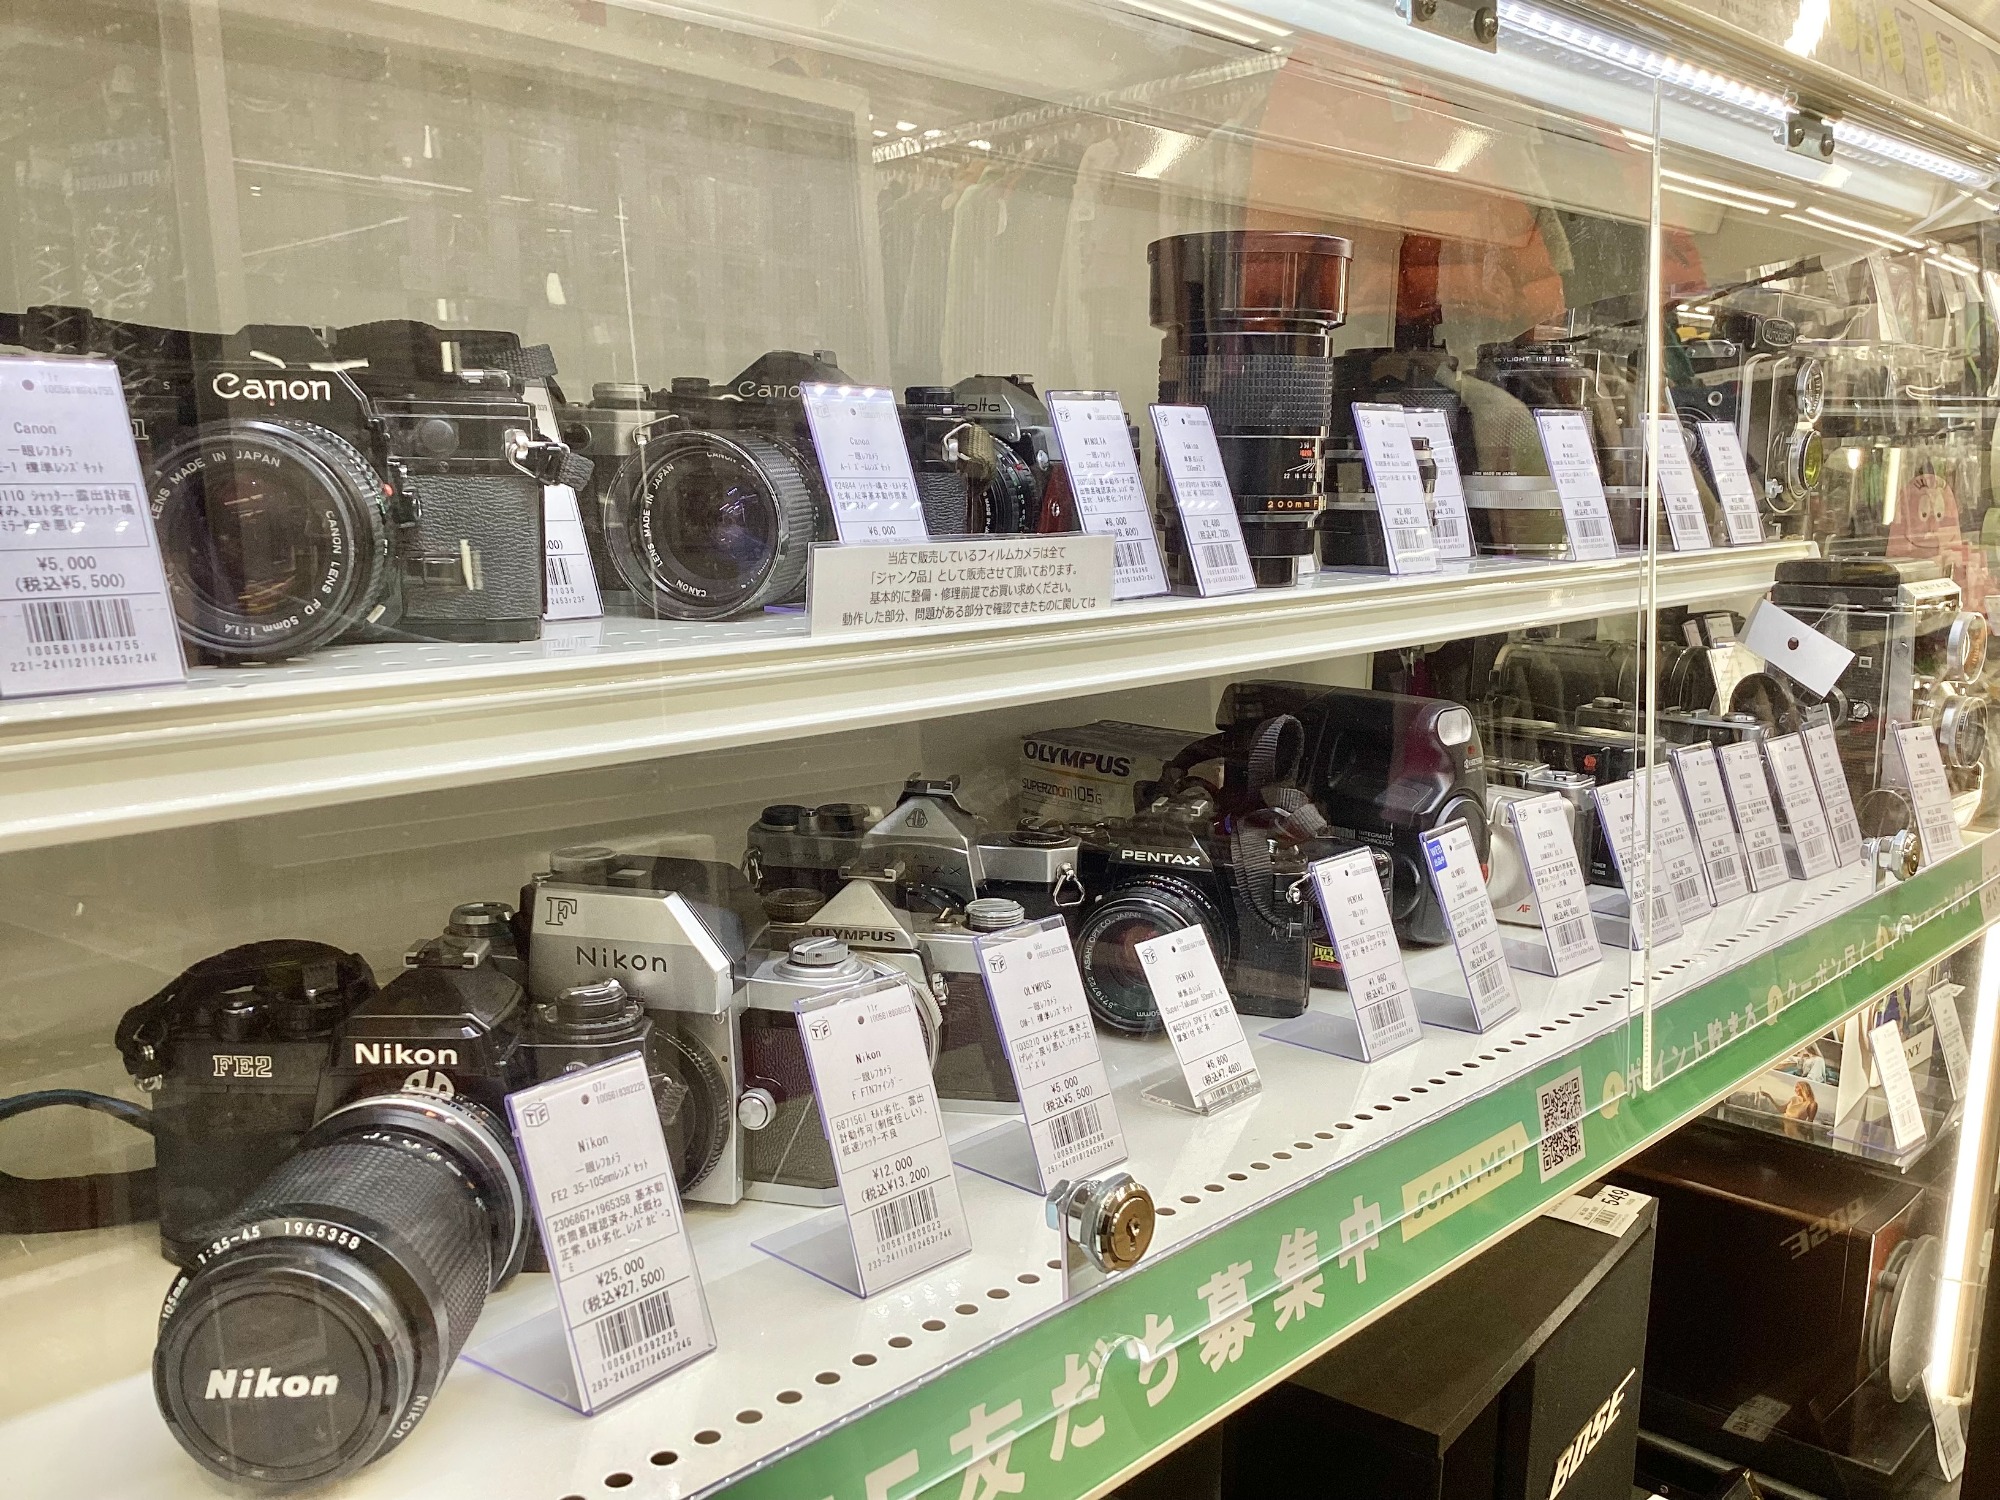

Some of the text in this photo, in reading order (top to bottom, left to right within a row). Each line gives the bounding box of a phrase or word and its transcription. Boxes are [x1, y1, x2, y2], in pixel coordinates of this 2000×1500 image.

[213, 372, 331, 401] Canon
[738, 381, 801, 400] Cano
[14, 422, 56, 434] Canon
[150, 450, 281, 520] LENS MADE IN JAPAN
[643, 508, 652, 538] MADE
[652, 463, 675, 490] JAPAN
[868, 526, 896, 536] ¥6,000
[1104, 516, 1128, 526] ¥8,000
[325, 510, 342, 554] CANON
[37, 556, 96, 572] ¥5,000
[888, 546, 1067, 566] 当店で販売しているフィルムカメラは全て
[16, 573, 126, 593] (税込¥5,500)
[321, 562, 341, 595] LENS
[870, 564, 1078, 585] 「ジャンク品」として販売させて頂いております。
[676, 578, 707, 598] CANON
[870, 582, 1072, 605] 基本的に整備・修理前提でお買い求めください。
[304, 598, 322, 616] FD
[842, 597, 1096, 626] 動作した部分、問題がある部分で確認できたものに関しては
[1024, 740, 1132, 778] OLYMPUS
[1122, 850, 1200, 866] PENTAX
[545, 896, 578, 926] F
[1114, 912, 1142, 921] JAPAN
[1516, 904, 1532, 912] AF
[1088, 928, 1103, 943] OPT
[576, 946, 667, 973] Nikon
[1084, 944, 1094, 971] ASAHI
[1174, 970, 1196, 984] PENTAX
[1023, 980, 1052, 996] OLYMPUS
[354, 1043, 458, 1065] Nikon
[855, 1050, 882, 1065] Nikon
[1206, 1054, 1229, 1070] ¥6,800
[212, 1054, 273, 1078] FE2
[1051, 1076, 1079, 1094] ¥5,000
[1043, 1085, 1094, 1114] (税込¥5,500)
[836, 1113, 867, 1131] 6871561
[577, 1134, 610, 1153] Nikon
[872, 1156, 914, 1180] ¥12,000
[861, 1165, 930, 1204] (税込¥13,200)
[1414, 1164, 1473, 1219] SCAN
[550, 1189, 568, 1204] FE2
[1601, 1190, 1630, 1207] 549
[283, 1221, 361, 1250] 1965358
[596, 1256, 645, 1288] ¥25,000
[582, 1266, 666, 1315] (税込¥27,500)
[204, 1368, 340, 1400] Nikon
[392, 1395, 429, 1439] Nikon
[1549, 1366, 1636, 1500] BOSE
